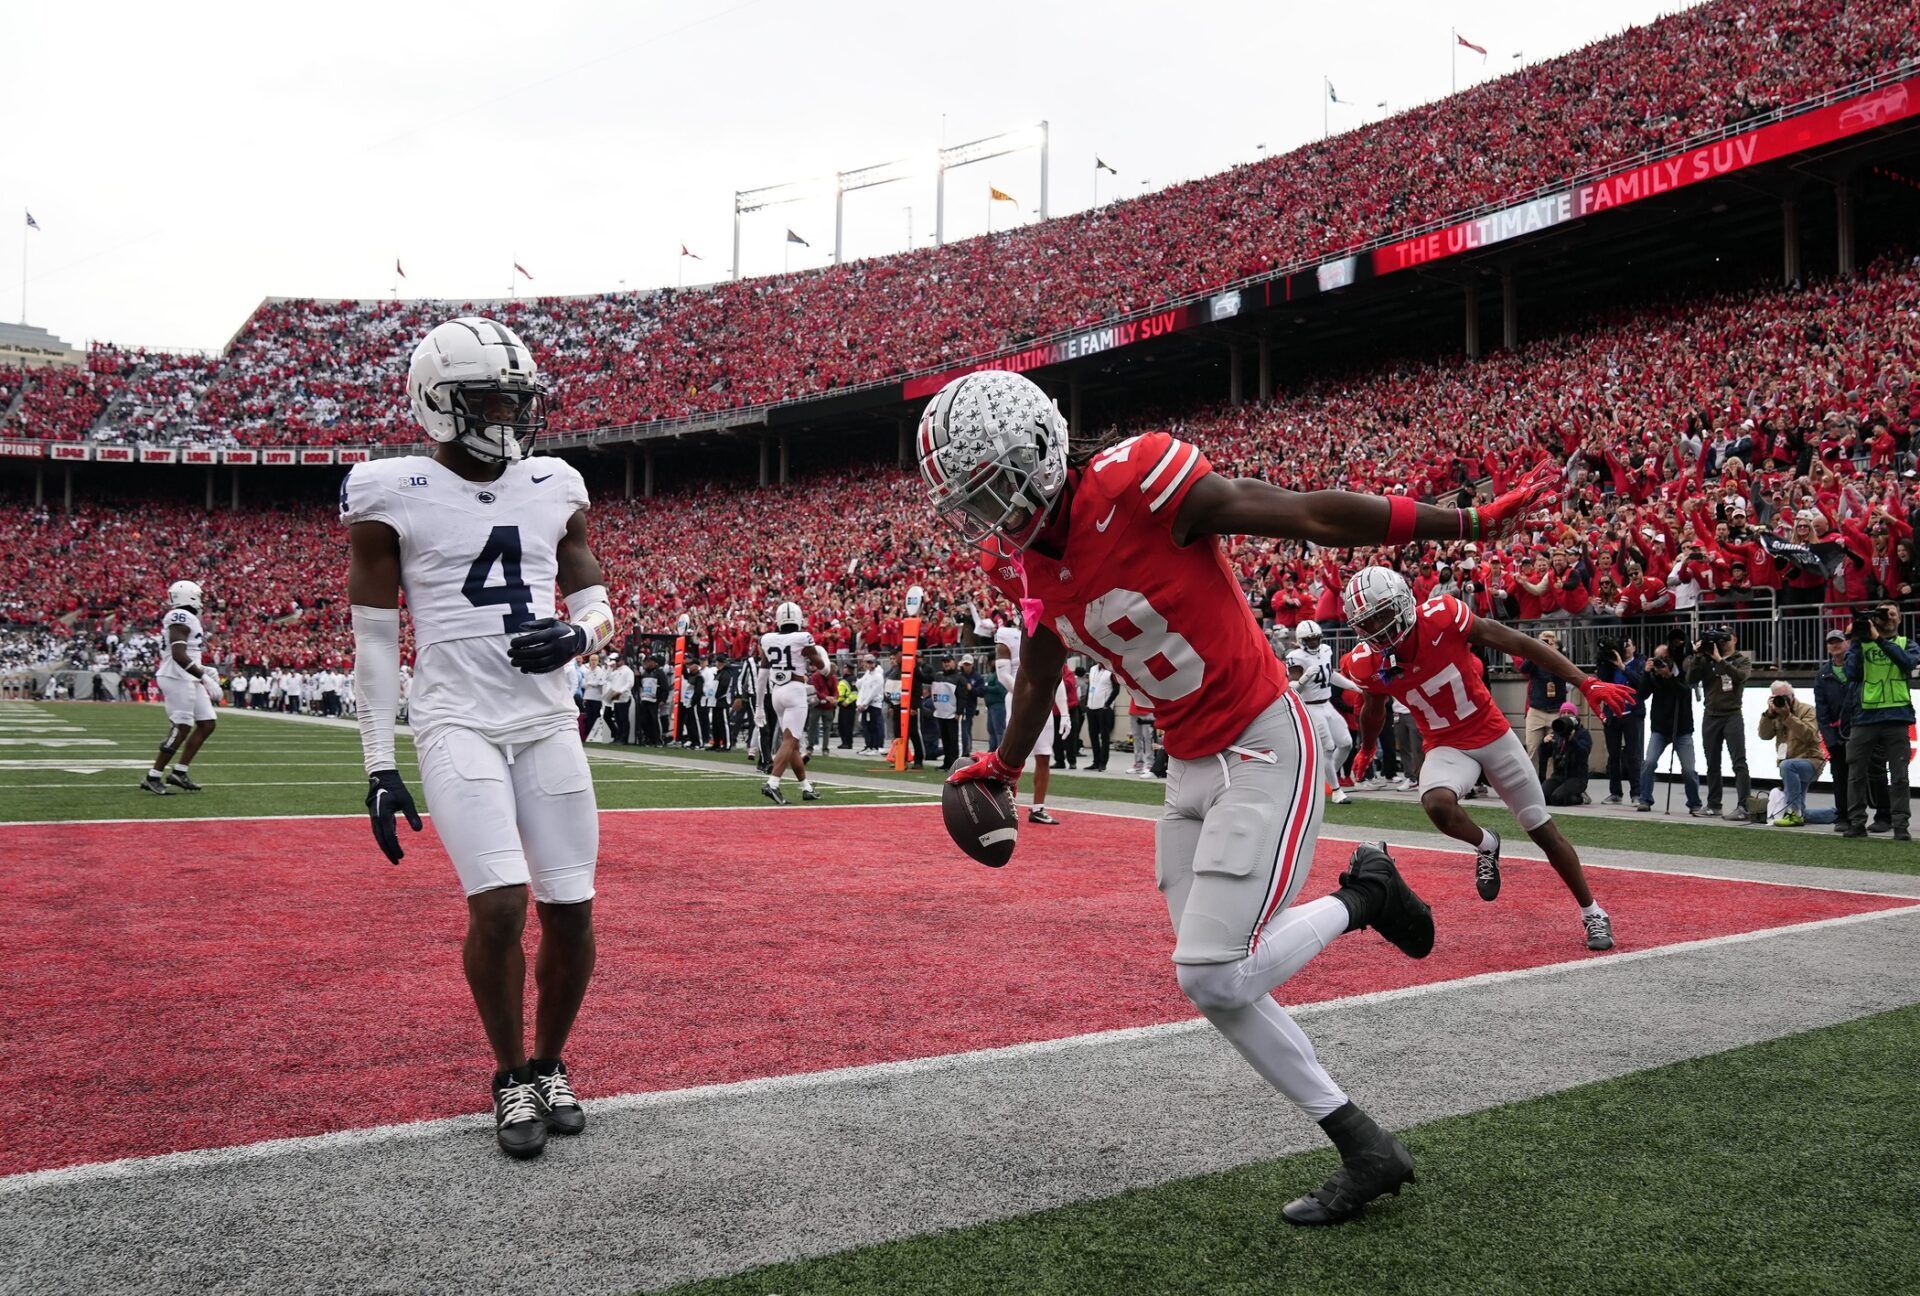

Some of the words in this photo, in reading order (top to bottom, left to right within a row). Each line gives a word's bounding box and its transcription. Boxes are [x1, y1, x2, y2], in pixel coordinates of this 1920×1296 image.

[1396, 236, 1440, 268] THE
[1447, 193, 1572, 250] ULTIMATE
[1580, 157, 1685, 212] FAMILY
[1693, 134, 1758, 179] SUV
[1005, 339, 1077, 373] ULTIMATE
[1081, 322, 1137, 355] FAMILY
[1141, 312, 1176, 337] SUV
[0, 443, 41, 456] PIONS
[265, 453, 291, 463] 1970
[341, 452, 366, 462] 2014
[461, 525, 537, 634] 4
[171, 612, 187, 623] 36
[768, 645, 796, 671] 21
[1055, 587, 1206, 709] 18
[1406, 662, 1479, 730] 17
